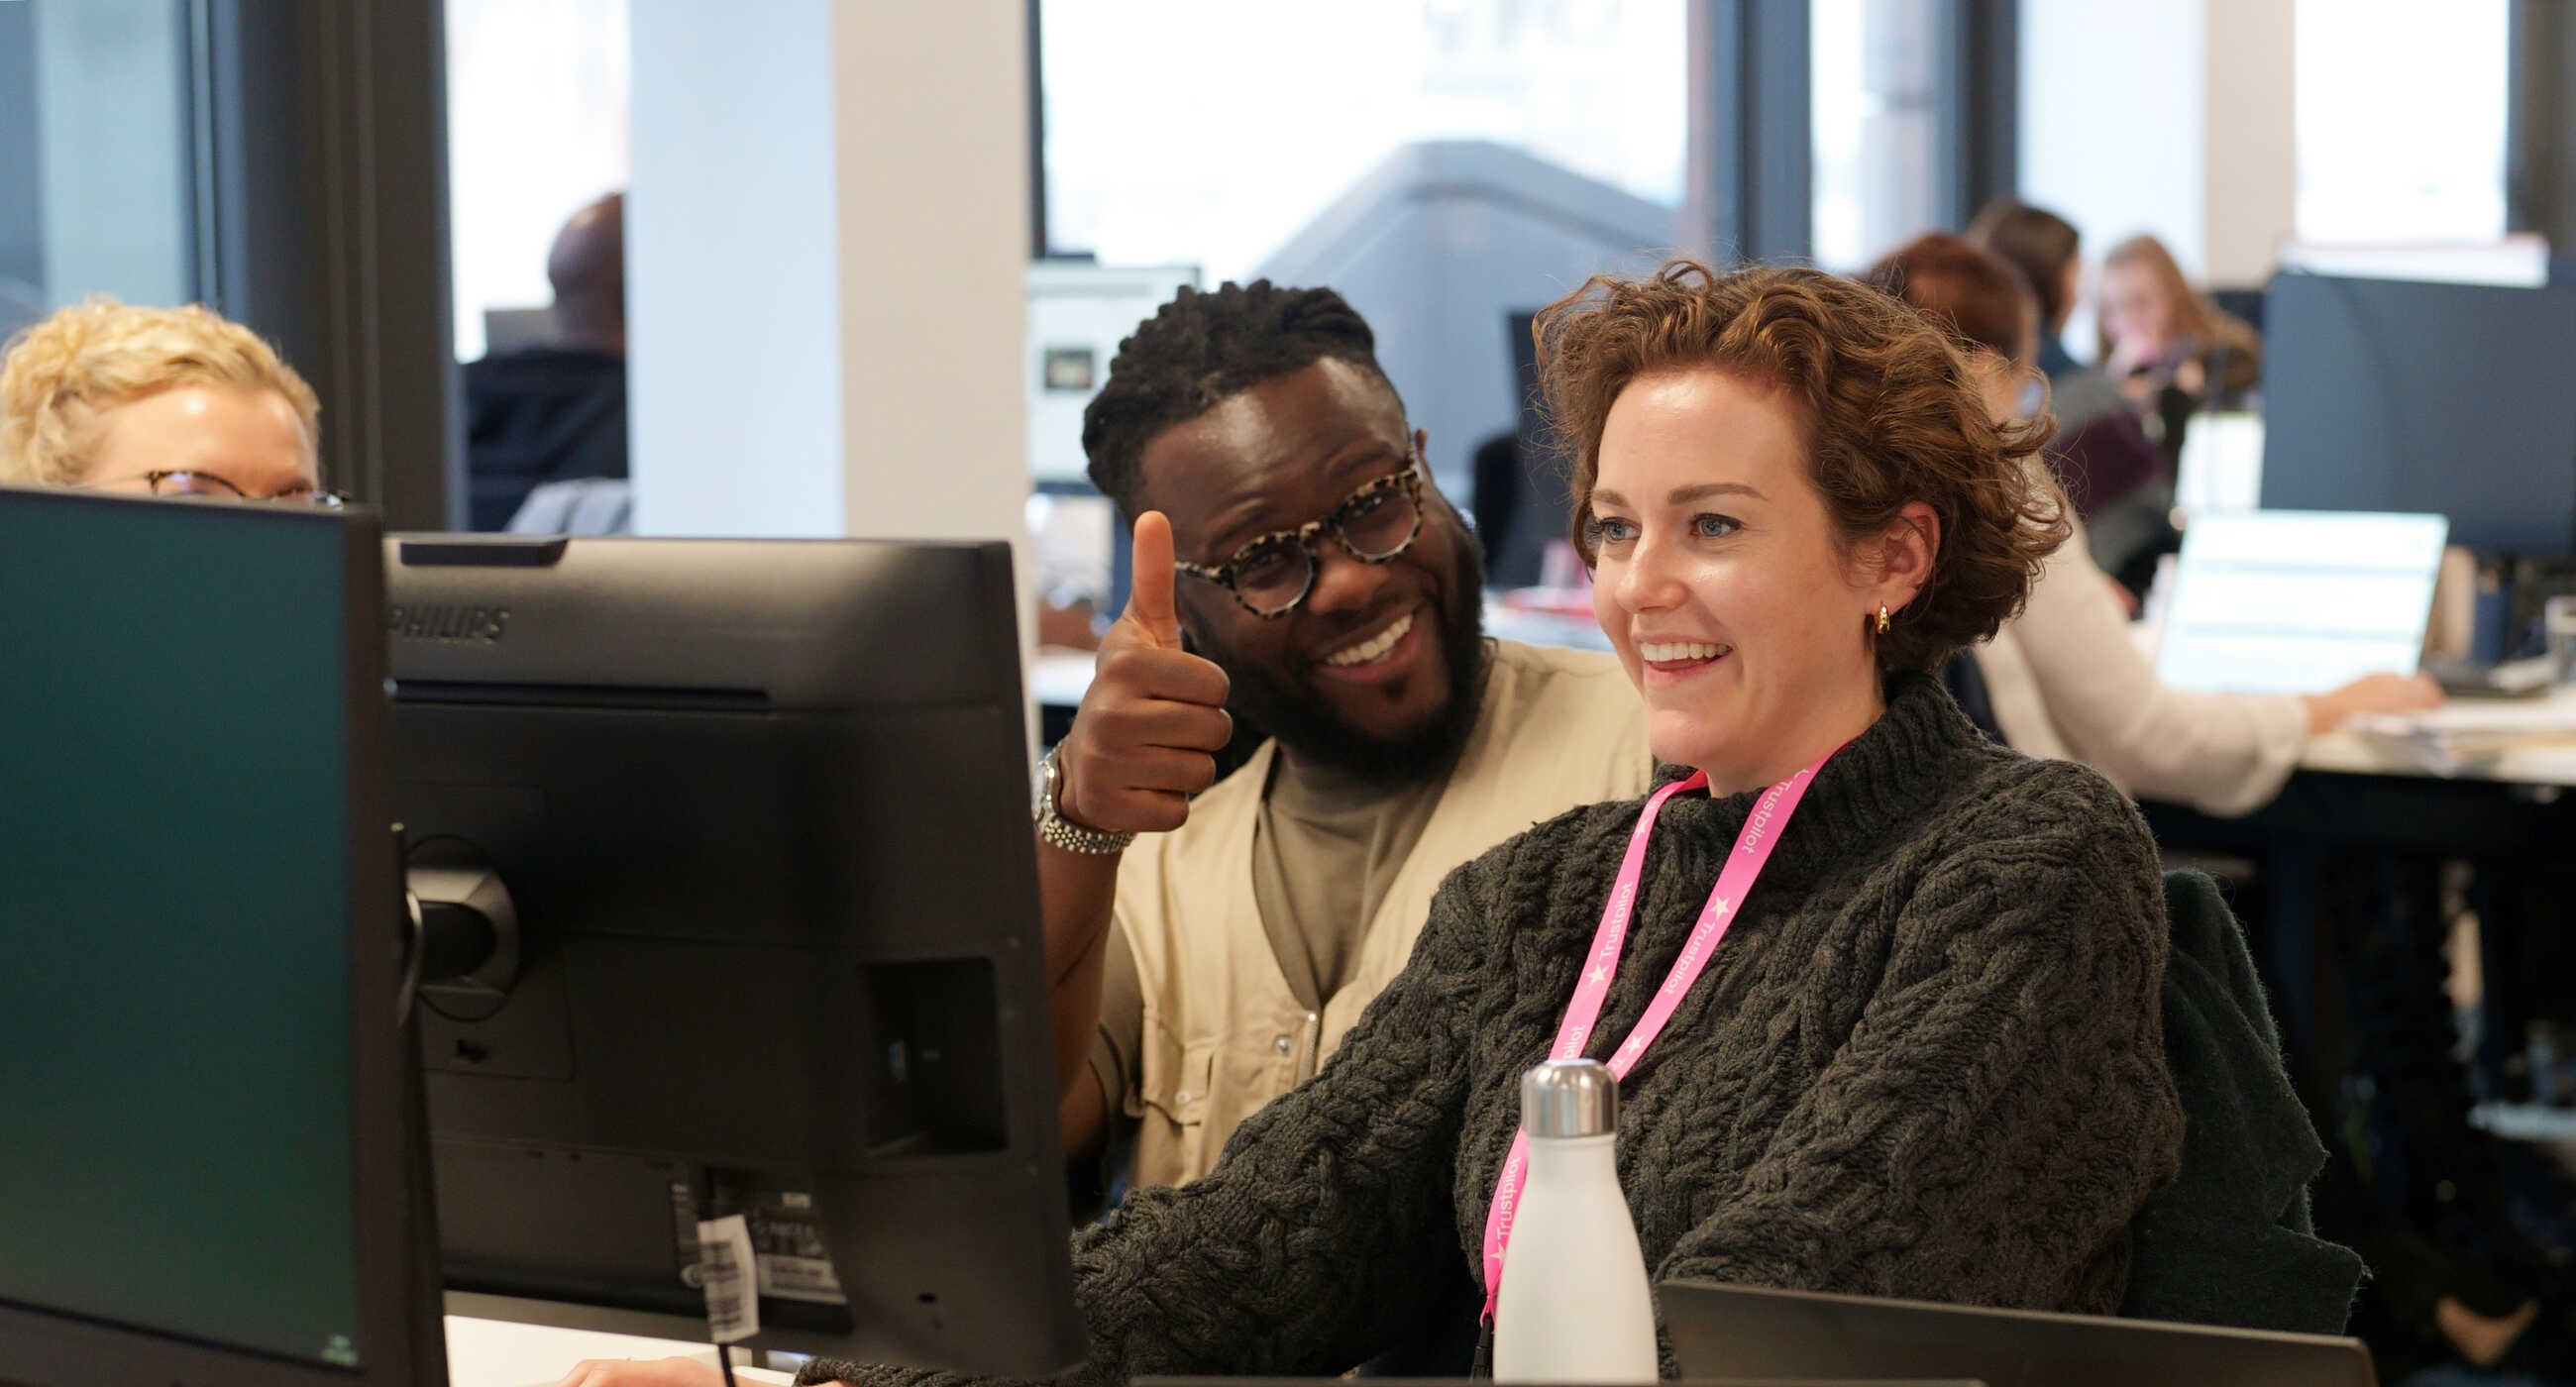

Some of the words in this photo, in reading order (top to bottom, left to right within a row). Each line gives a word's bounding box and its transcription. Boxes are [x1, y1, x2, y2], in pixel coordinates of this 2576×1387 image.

[386, 605, 510, 644] PHILIPS
[1741, 780, 1793, 854] Trustpilot
[1599, 882, 1634, 961] Trustpilot
[1664, 921, 1716, 995] Trustpilot
[1561, 1023, 1585, 1059] pilot
[1496, 1155, 1522, 1239] Trustpilot
